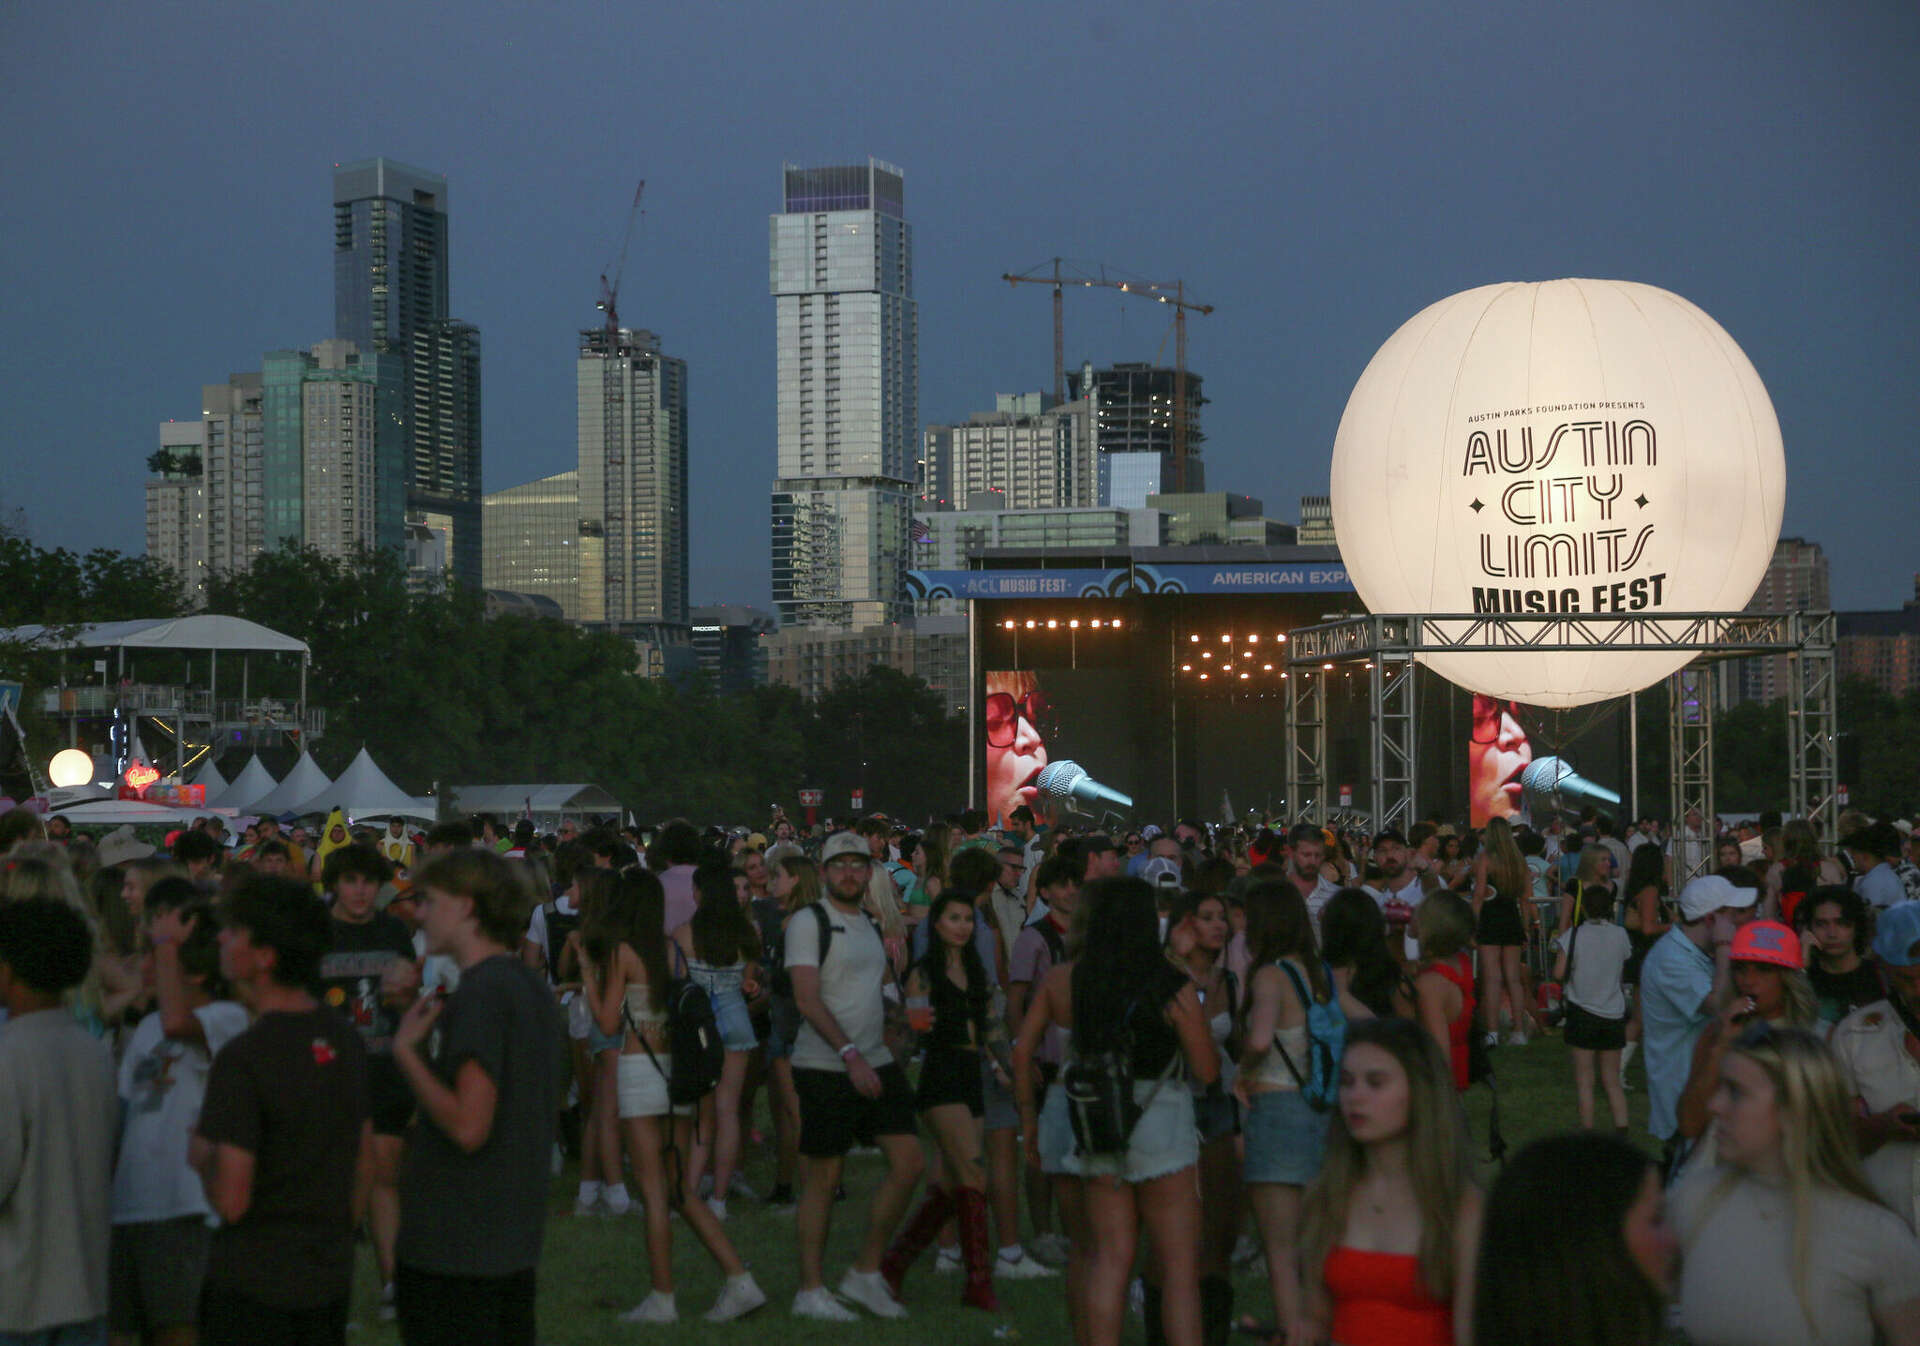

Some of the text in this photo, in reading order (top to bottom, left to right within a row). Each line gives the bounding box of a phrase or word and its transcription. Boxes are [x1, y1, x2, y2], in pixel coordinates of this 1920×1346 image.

[1468, 401, 1646, 423] AUSTIN PARKS FOUNDATION PRESENTS
[1463, 419, 1657, 476] AUSTIN
[1501, 473, 1623, 526] CITY
[1480, 523, 1655, 578] LIMITS
[967, 578, 1067, 593] ACL MUSIC FEST
[1212, 572, 1303, 584] AMERICAN
[1472, 573, 1667, 613] MUSIC FEST
